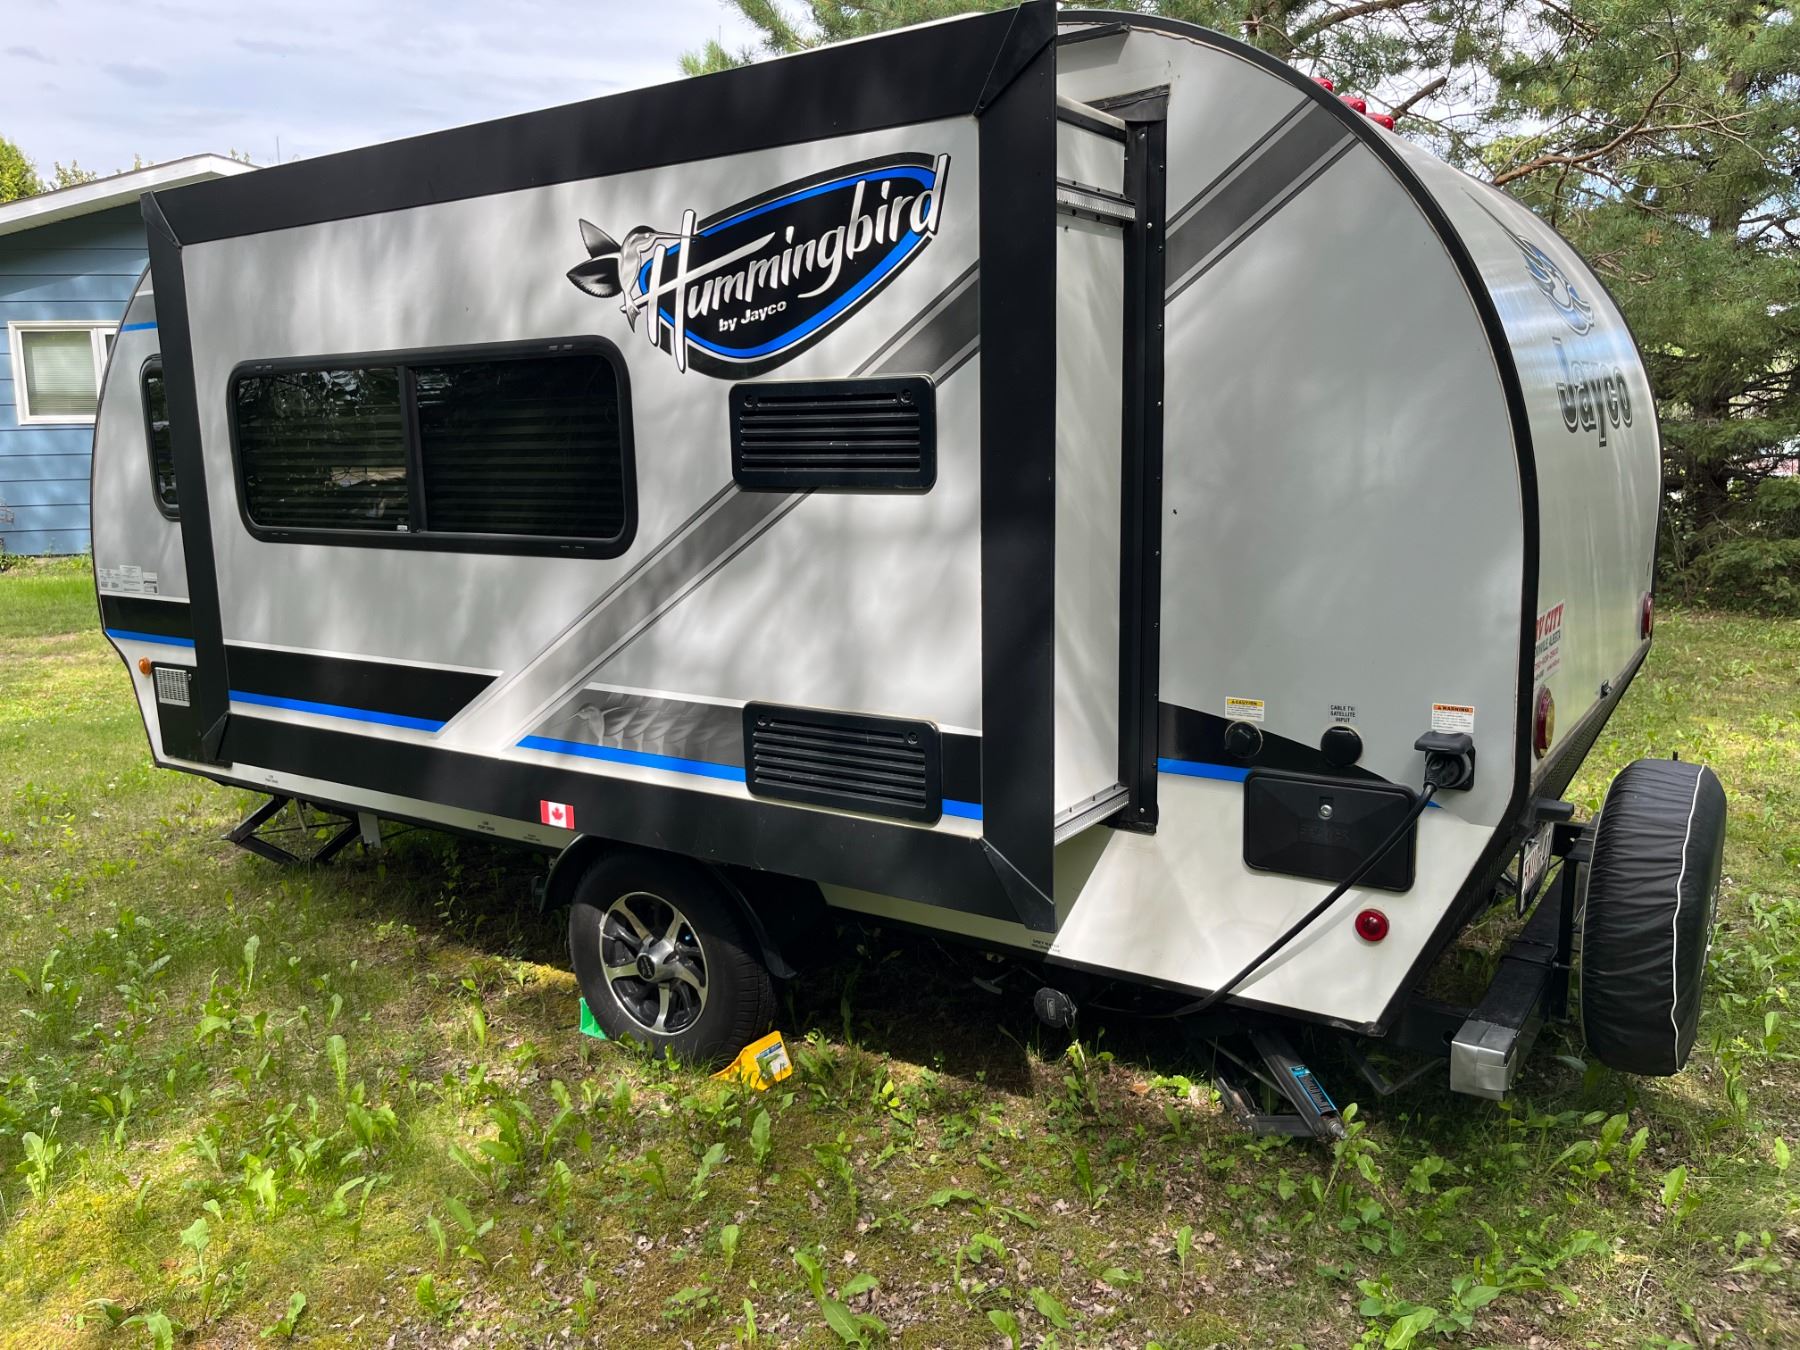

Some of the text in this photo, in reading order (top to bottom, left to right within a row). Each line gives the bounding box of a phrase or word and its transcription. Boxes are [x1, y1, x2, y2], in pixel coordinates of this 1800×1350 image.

[634, 153, 951, 373] Hummingbird
[718, 300, 787, 333] by Jayco
[1544, 603, 1565, 635] CITY
